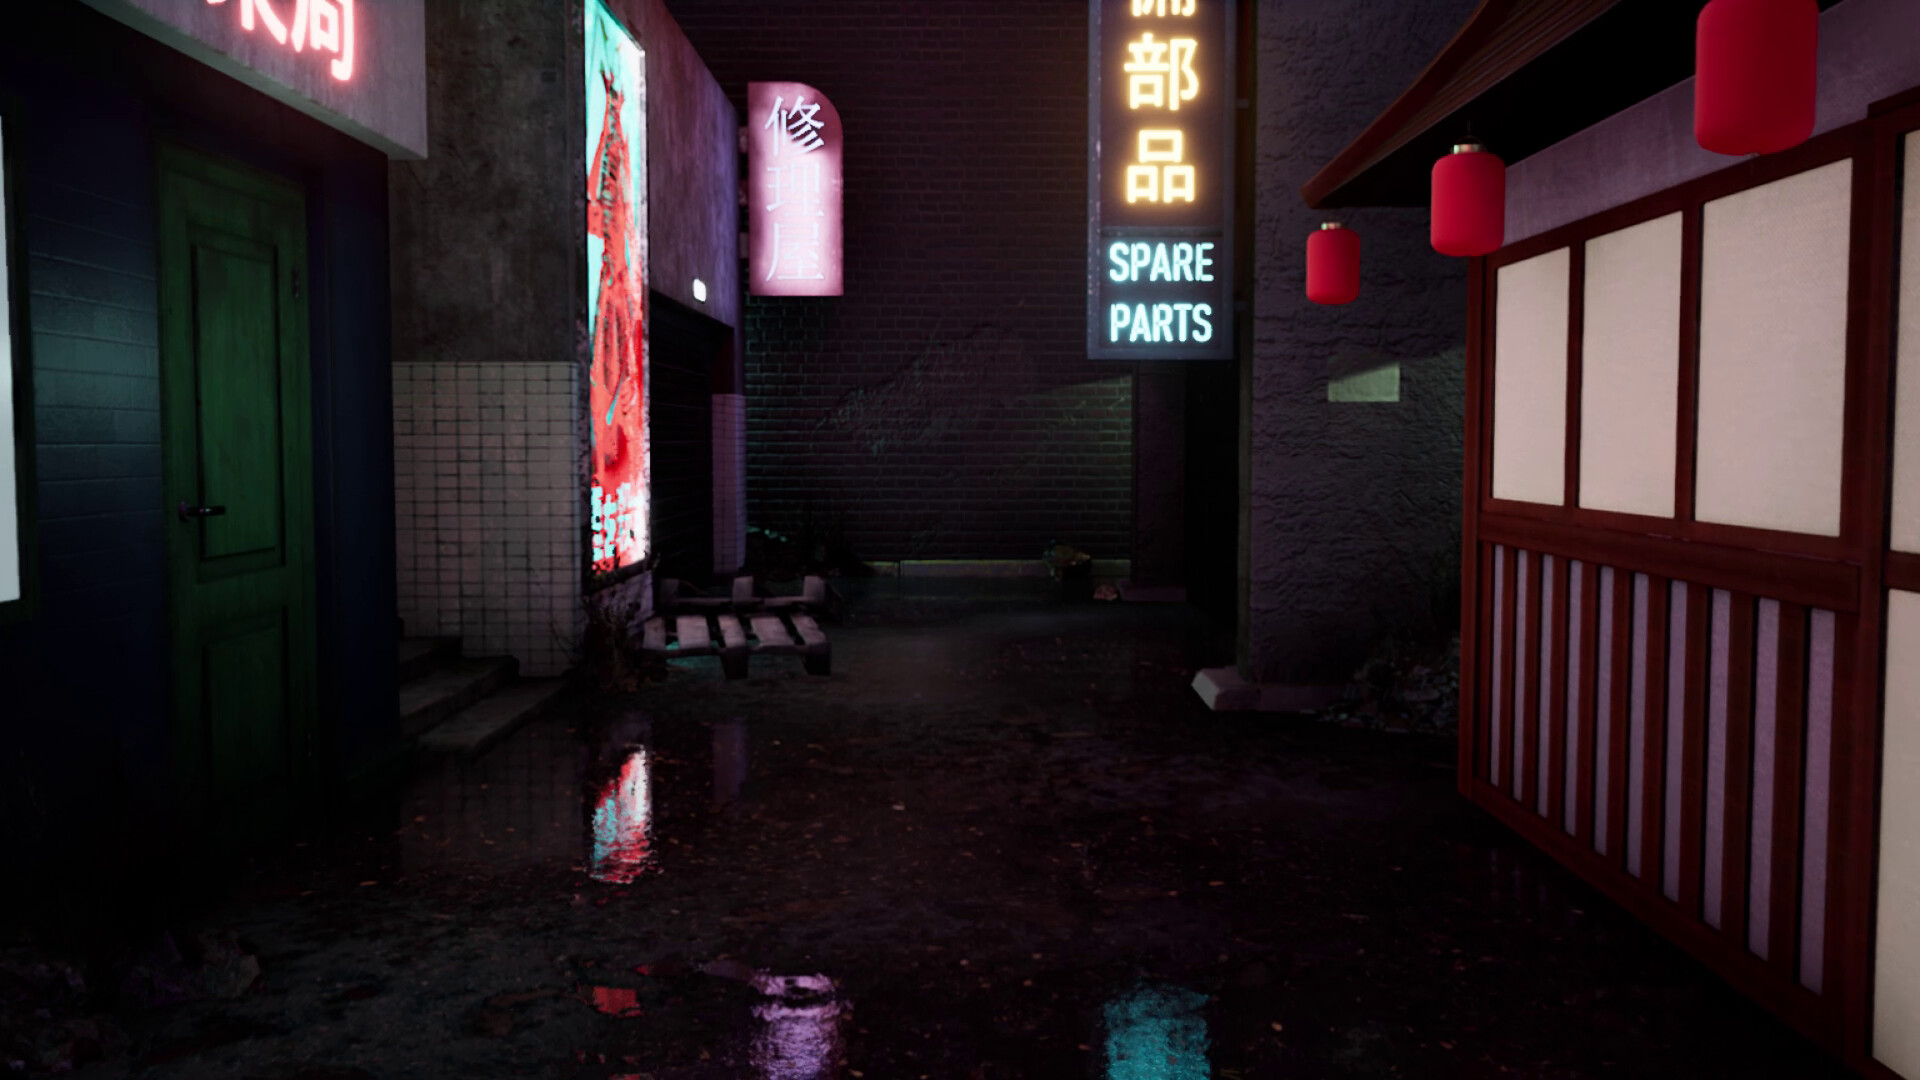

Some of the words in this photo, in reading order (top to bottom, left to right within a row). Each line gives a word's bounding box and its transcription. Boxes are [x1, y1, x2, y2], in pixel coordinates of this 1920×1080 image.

[1124, 0, 1199, 204] 部品
[764, 95, 825, 281] 修理屋
[1109, 242, 1214, 282] SPARE
[1110, 303, 1212, 342] PARTS
